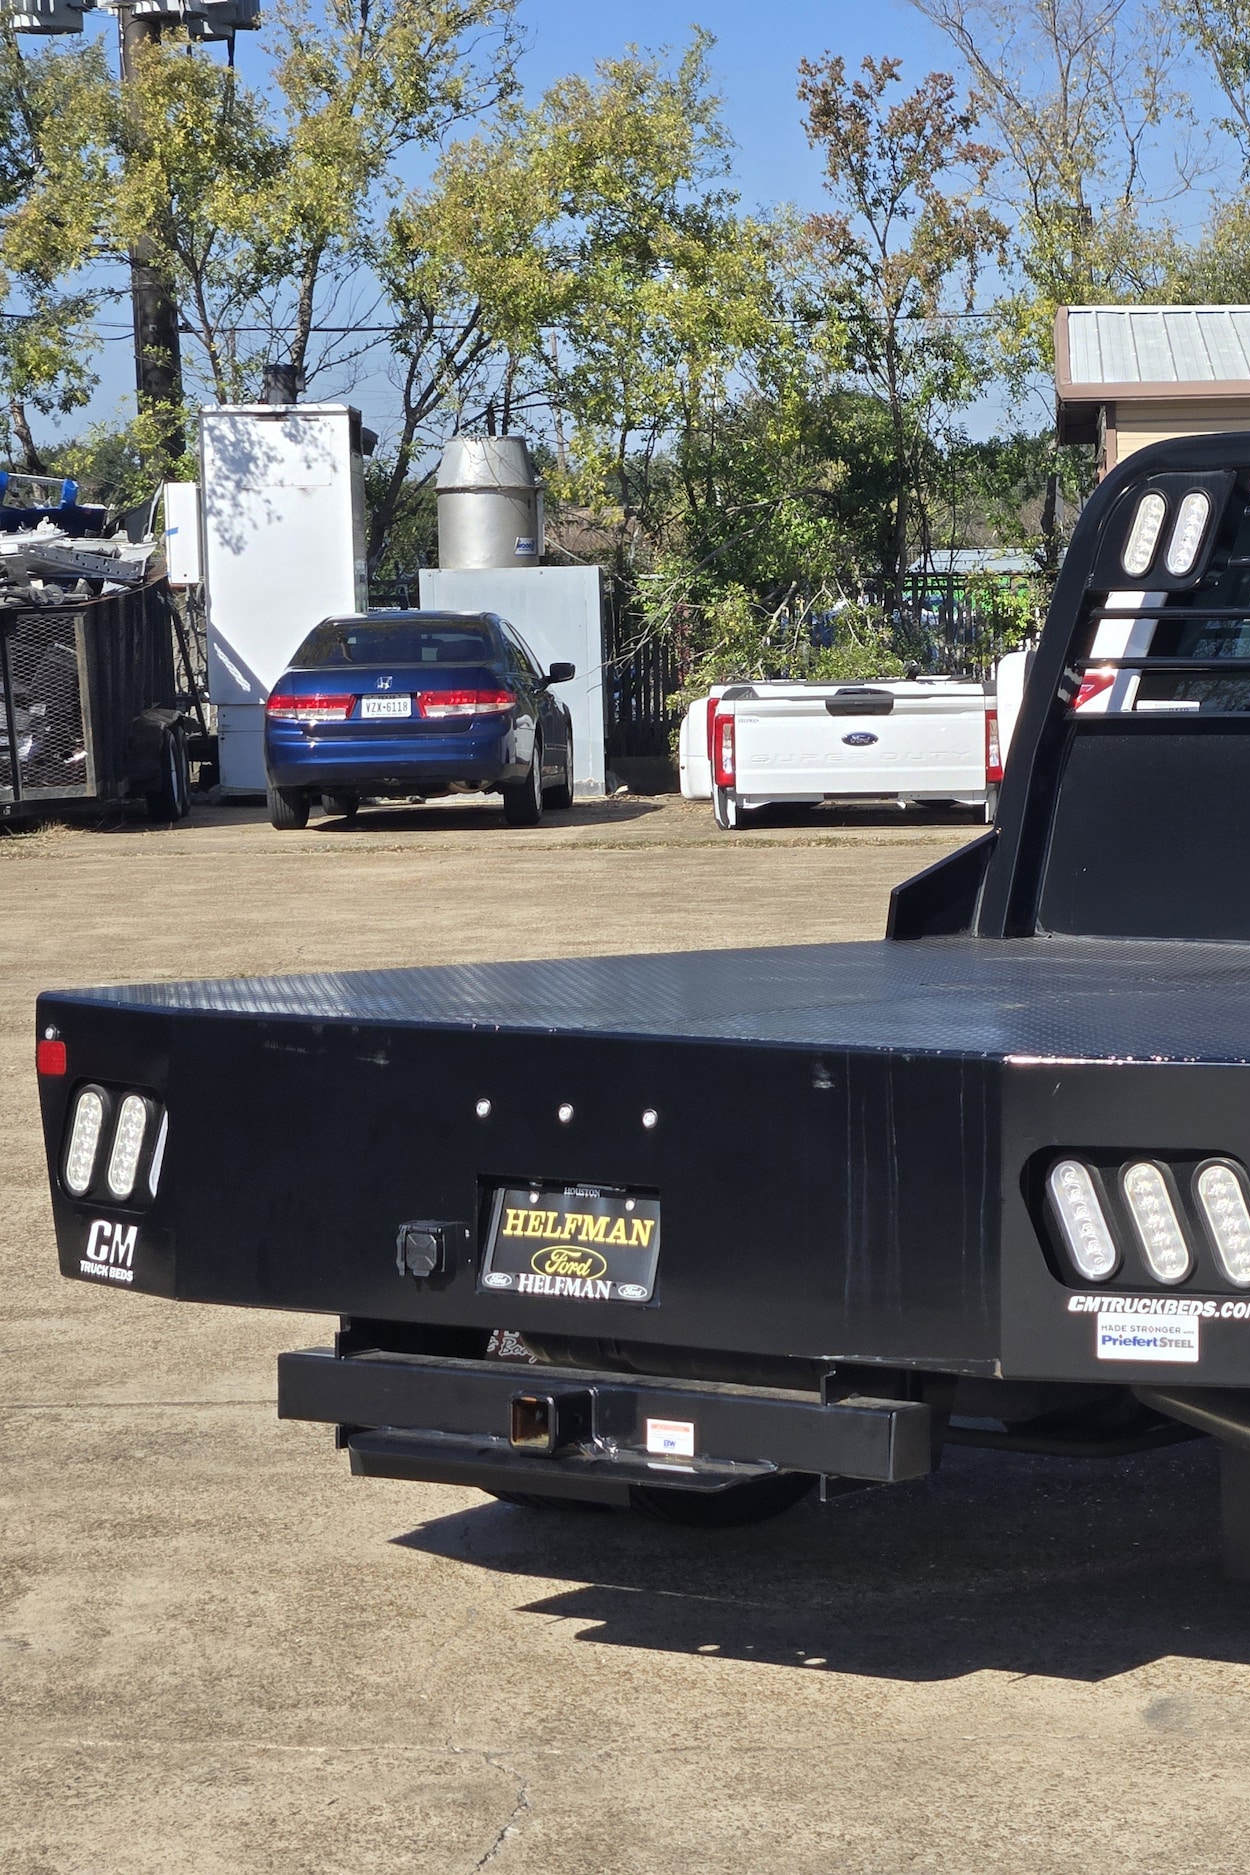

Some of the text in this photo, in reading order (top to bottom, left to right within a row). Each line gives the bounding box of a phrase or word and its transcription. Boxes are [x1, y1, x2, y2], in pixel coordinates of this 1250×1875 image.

[751, 751, 971, 765] SUPER DUTY
[564, 1187, 601, 1198] HOUSTON
[503, 1209, 655, 1248] HELFMAN
[86, 1219, 138, 1267] CM
[80, 1260, 133, 1282] TRUCK BEDS
[544, 1248, 593, 1276] Ford
[517, 1273, 613, 1300] HELFMAN
[1130, 1325, 1181, 1334] STRONGER
